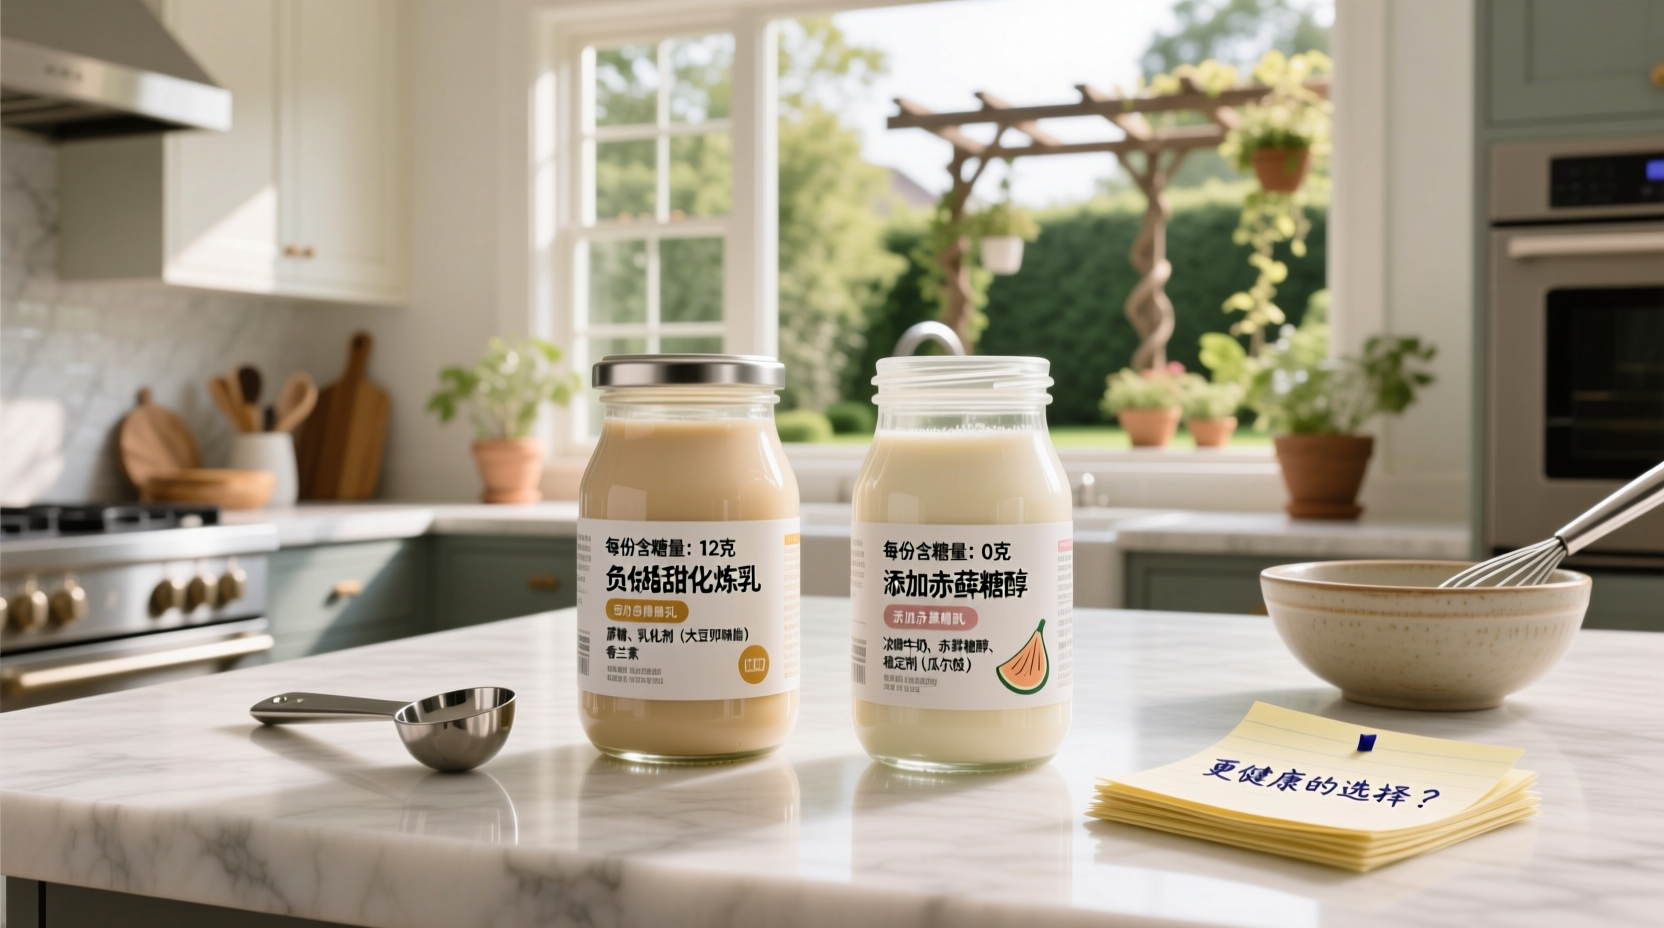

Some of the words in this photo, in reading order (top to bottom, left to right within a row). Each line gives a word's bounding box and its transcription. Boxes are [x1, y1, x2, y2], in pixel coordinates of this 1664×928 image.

[605, 536, 737, 558] 每份含糖量：12克
[883, 540, 1012, 562] 每份含糖量：0克
[1202, 757, 1441, 810] 更健康的选择？
